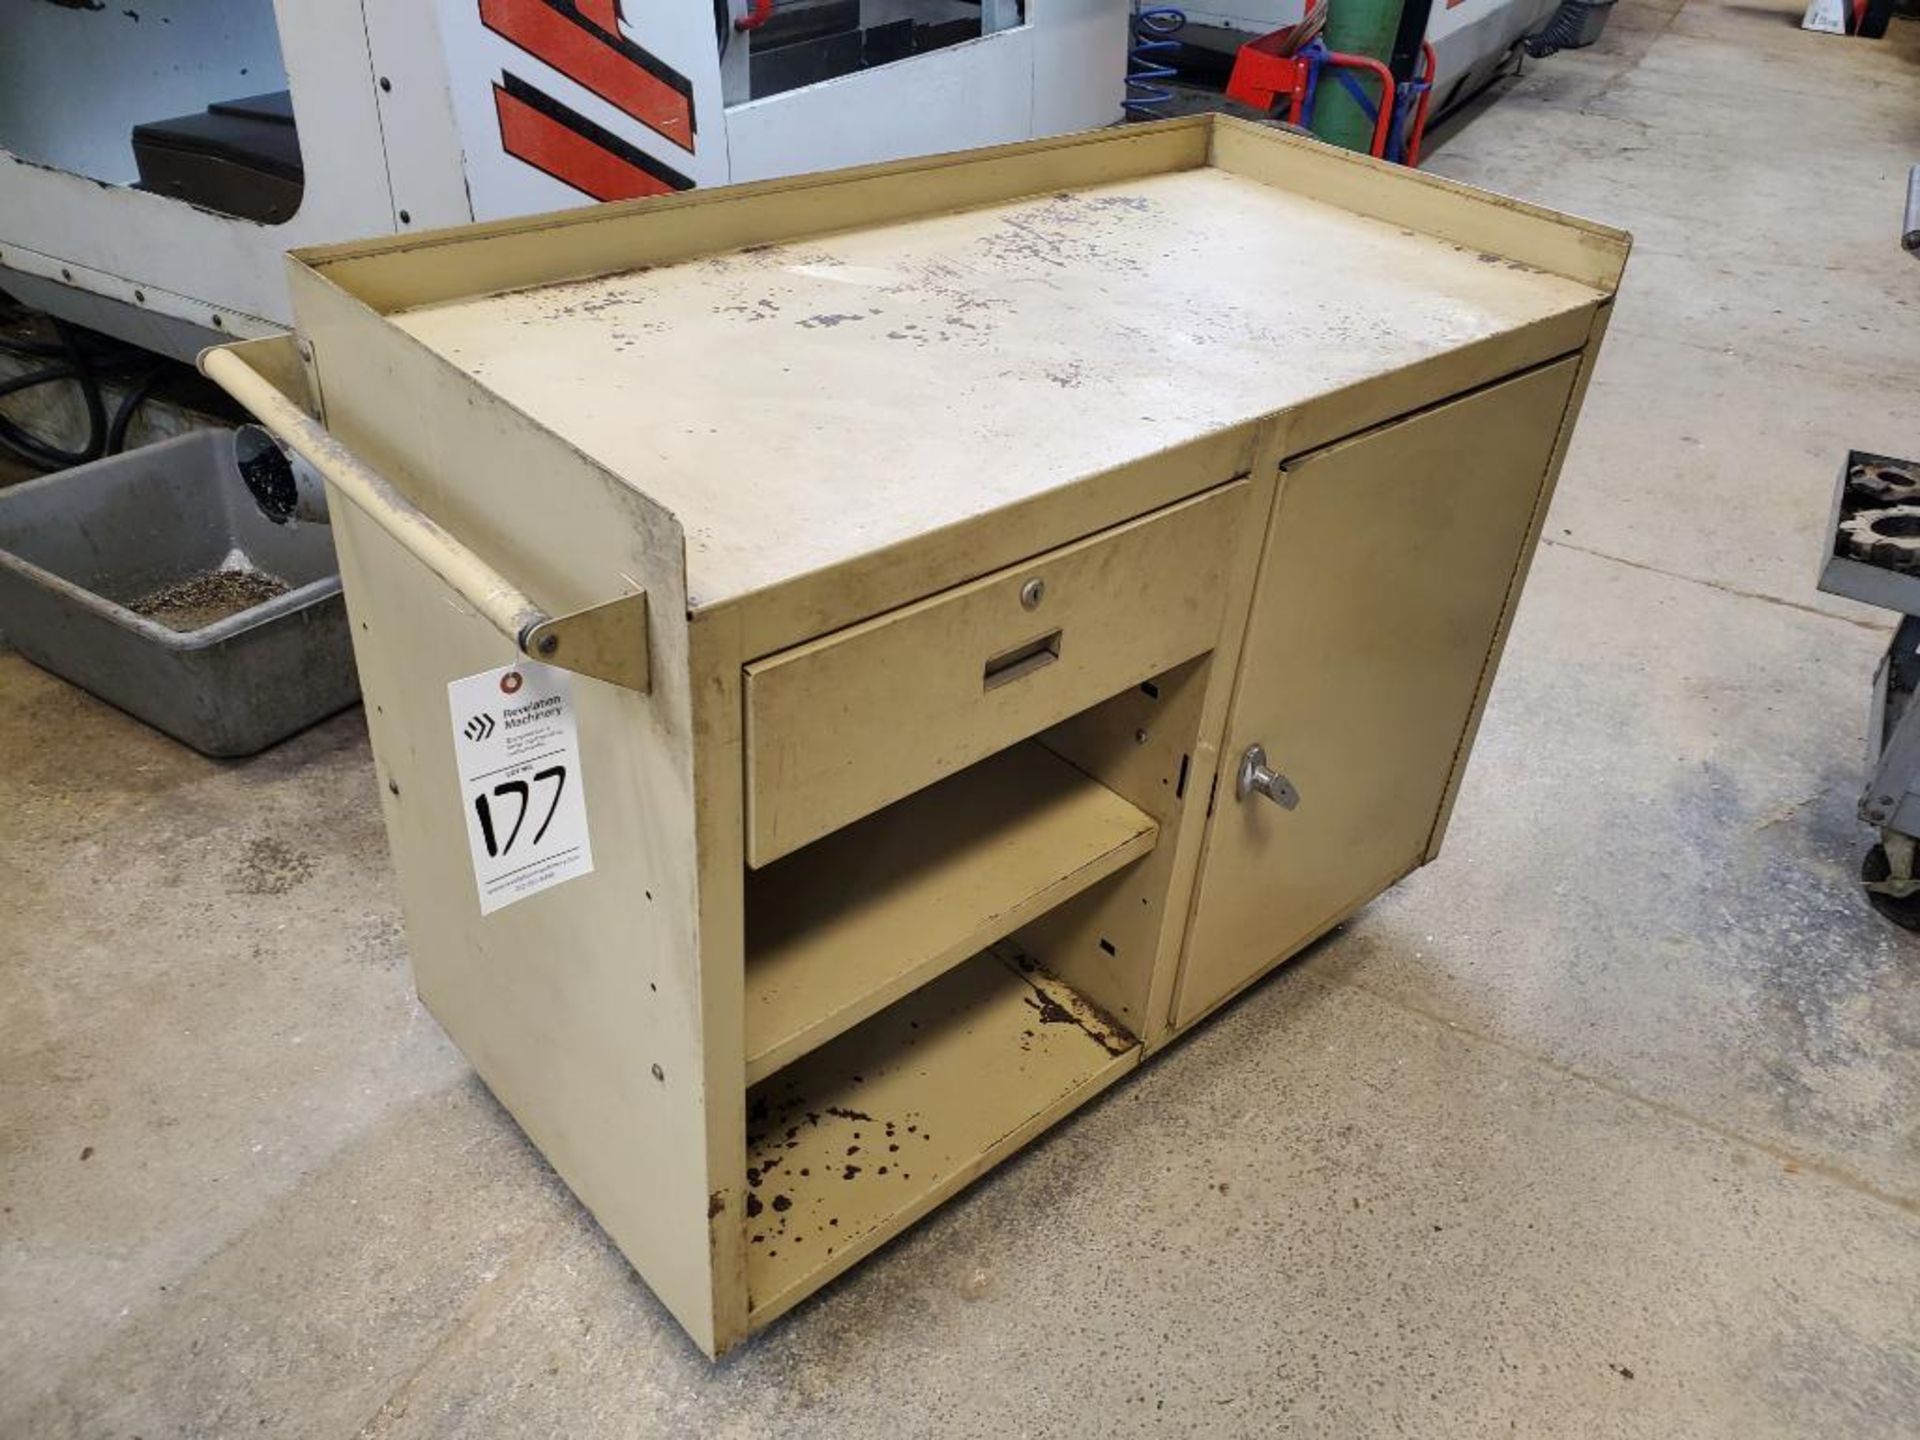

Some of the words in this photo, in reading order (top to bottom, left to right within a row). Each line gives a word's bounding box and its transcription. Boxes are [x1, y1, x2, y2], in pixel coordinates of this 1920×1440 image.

[503, 696, 562, 719] Revelation
[504, 706, 563, 730] Machinery
[475, 765, 566, 858] 177
